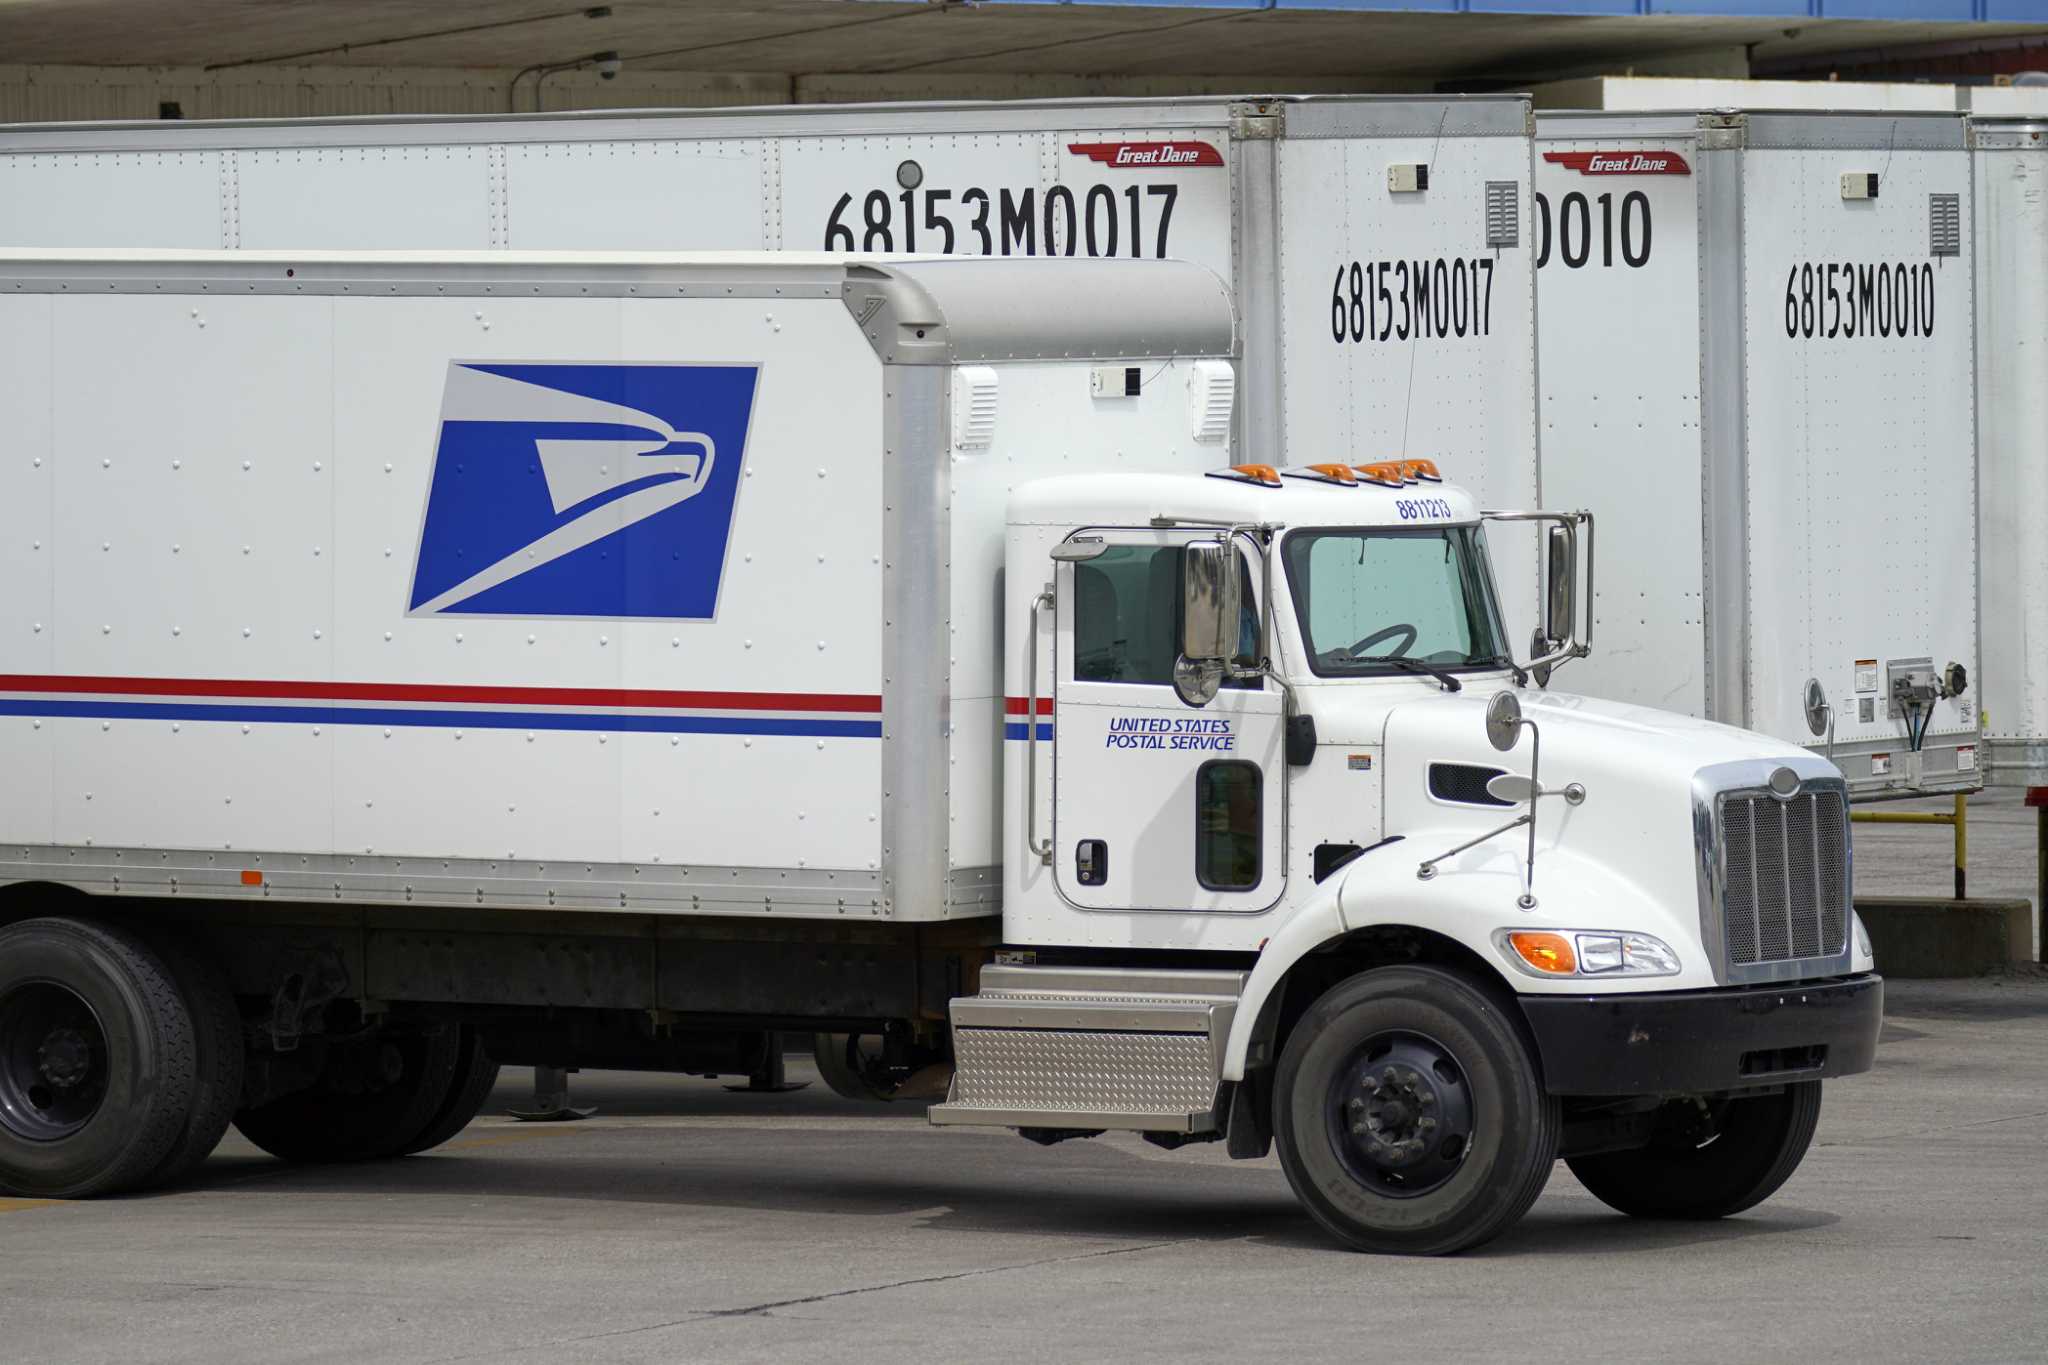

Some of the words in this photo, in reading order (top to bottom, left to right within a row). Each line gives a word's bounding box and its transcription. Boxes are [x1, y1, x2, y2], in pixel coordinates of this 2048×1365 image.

[1116, 146, 1159, 163] Great
[1159, 145, 1199, 163] Dane
[1588, 155, 1629, 172] Great
[1629, 154, 1667, 171] Dane
[824, 183, 1178, 258] 68153M0017
[1332, 257, 1494, 343] 68153M0017
[1785, 262, 1934, 338] 68153M0010
[1395, 498, 1451, 519] 8811213
[1110, 718, 1172, 732] UNITED
[1173, 719, 1231, 733] STATES
[1106, 734, 1167, 749] POSTAL
[1169, 735, 1236, 750] SERVICE
